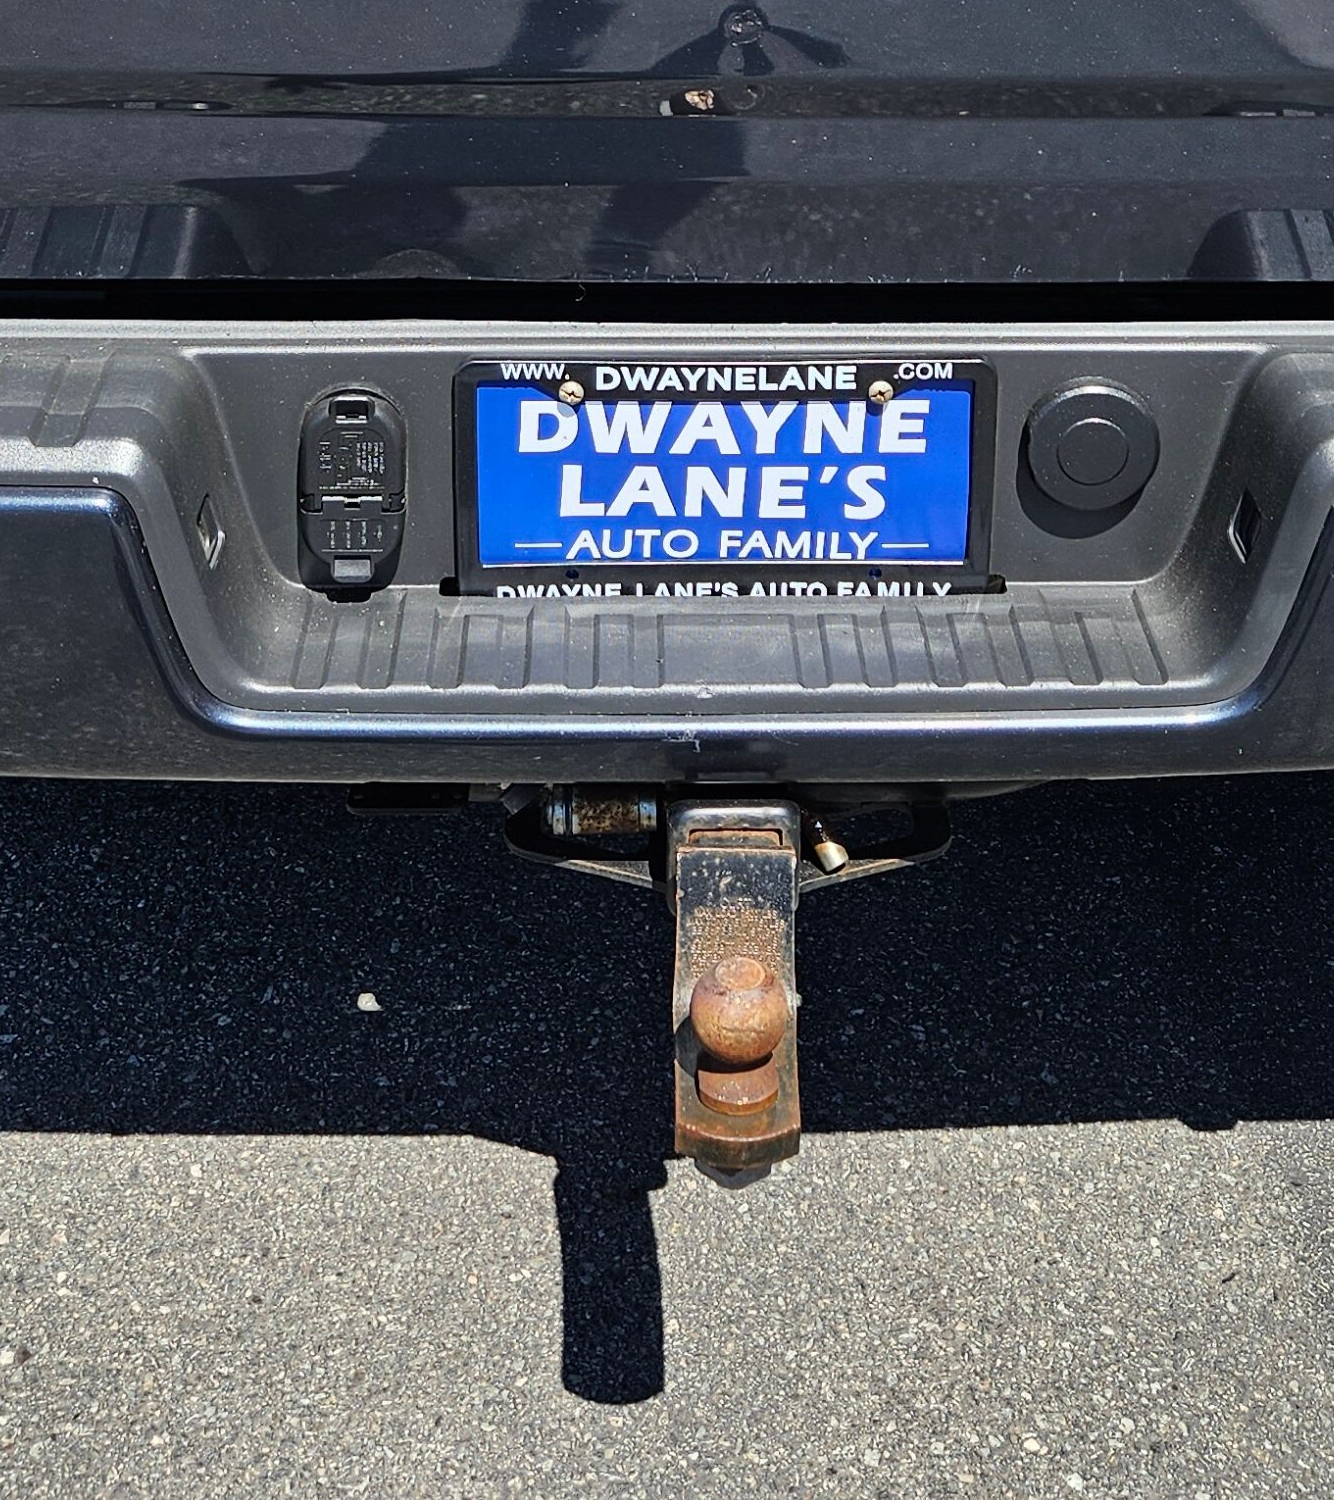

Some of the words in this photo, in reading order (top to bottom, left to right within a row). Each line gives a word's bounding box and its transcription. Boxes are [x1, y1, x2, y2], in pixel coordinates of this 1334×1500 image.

[500, 363, 570, 381] WWW.
[595, 366, 858, 391] DWAYNELANE
[893, 363, 954, 380] .COM
[518, 400, 930, 454] DWAYNE
[559, 464, 887, 520] LANE'S
[566, 529, 699, 560] AUTO
[718, 531, 878, 560] FAMILY
